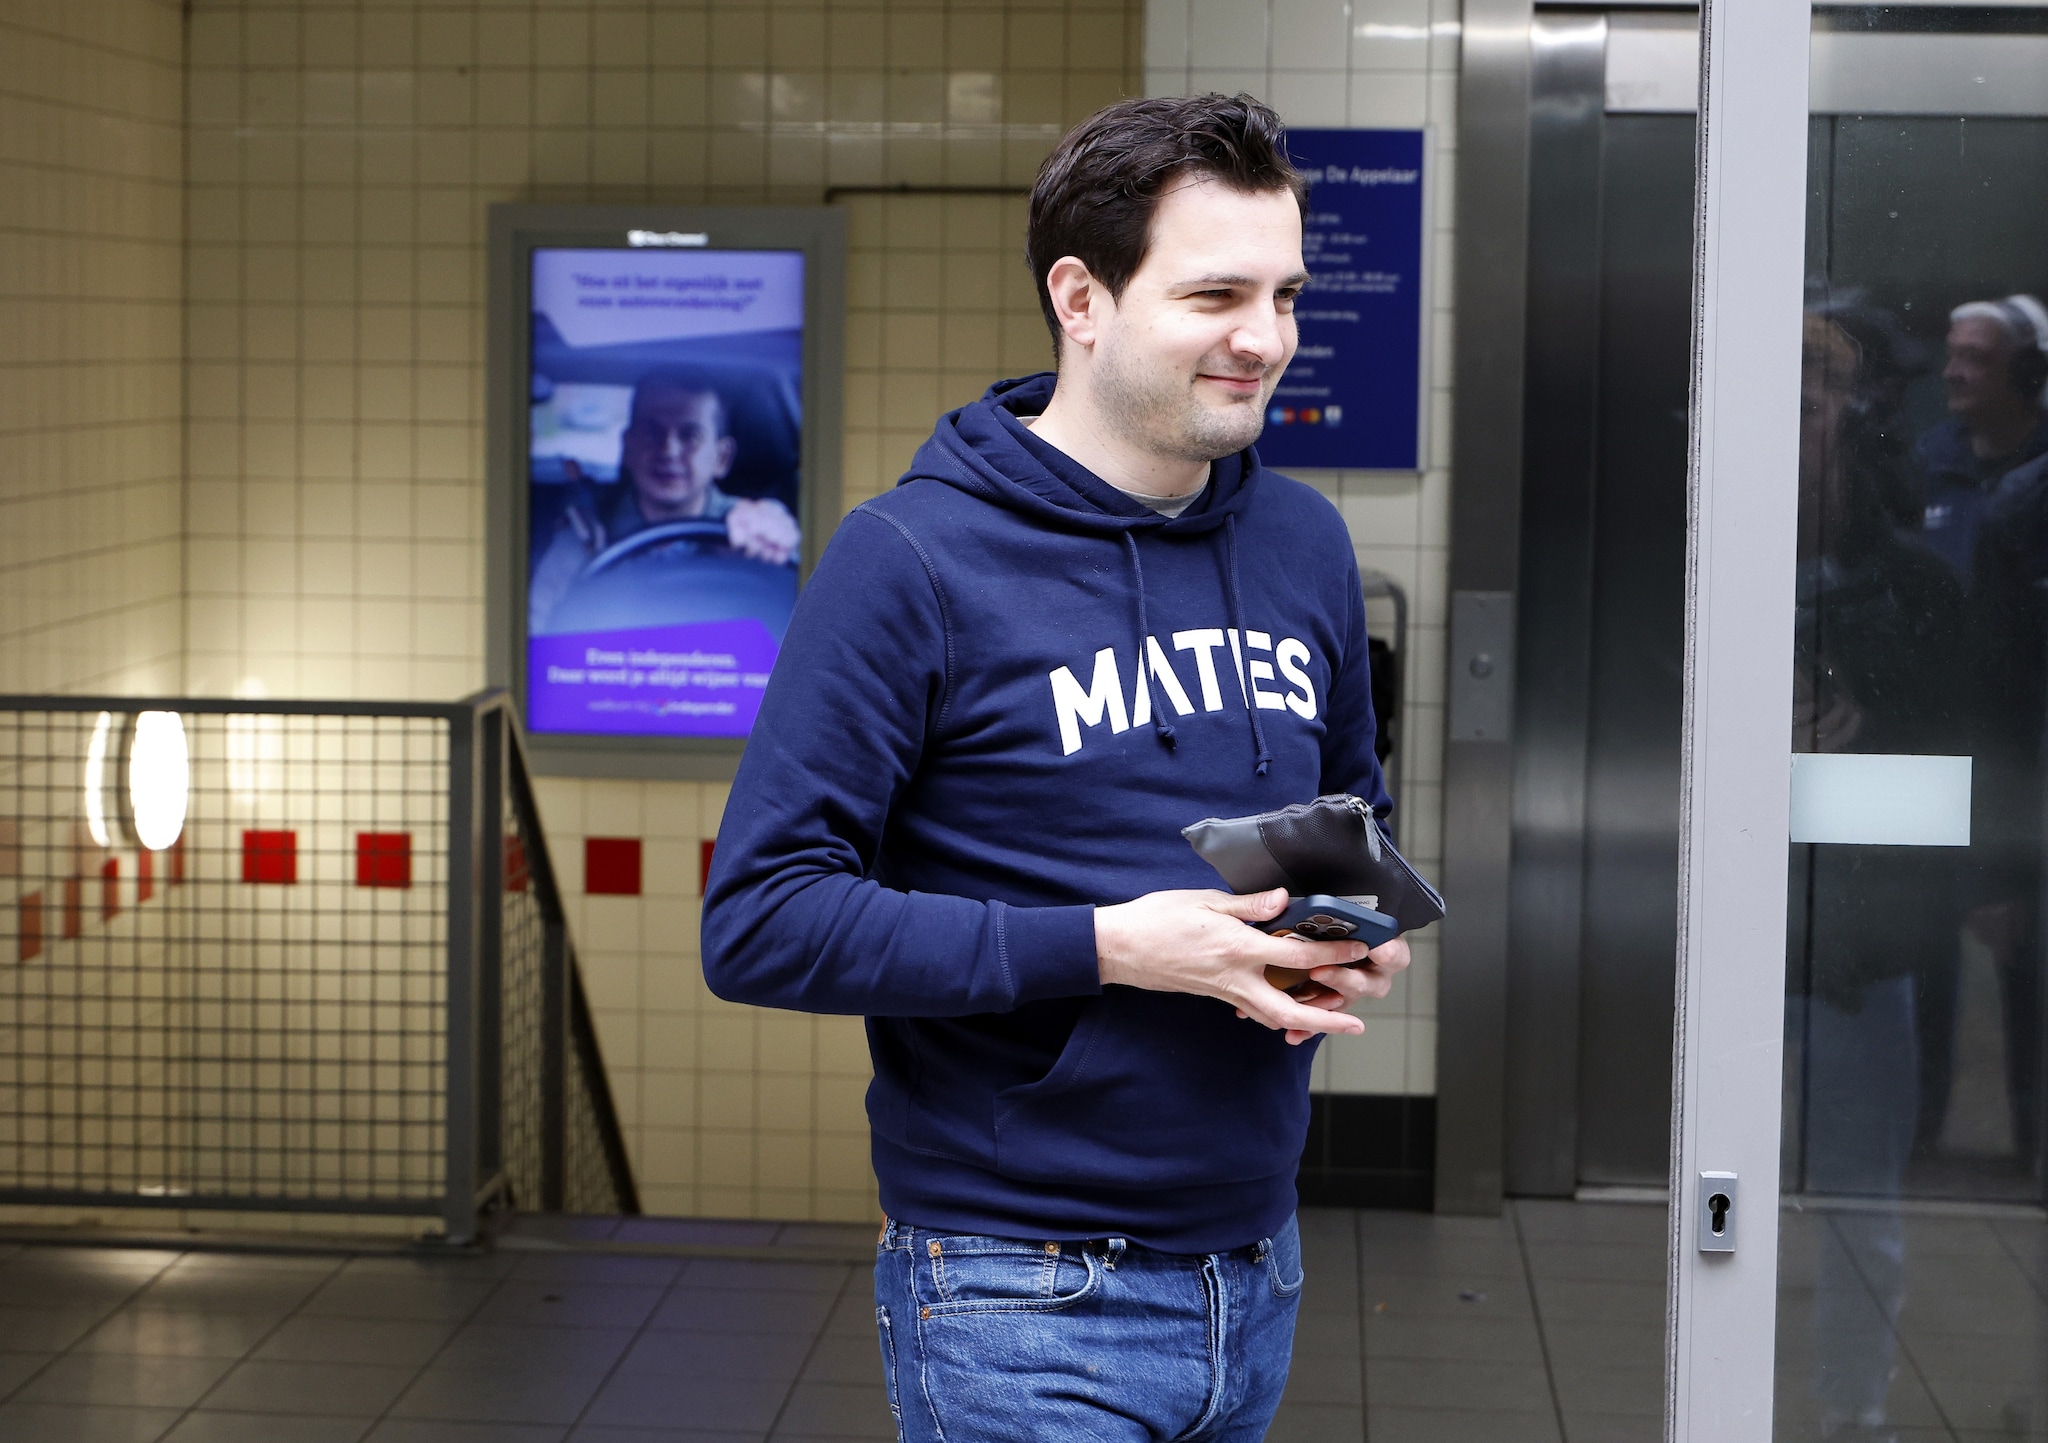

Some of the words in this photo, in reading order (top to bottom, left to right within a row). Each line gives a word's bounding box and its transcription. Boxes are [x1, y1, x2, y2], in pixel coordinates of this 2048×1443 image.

[1326, 165, 1348, 184] De
[1350, 166, 1419, 187] Appelaar
[1049, 628, 1317, 756] MATES
